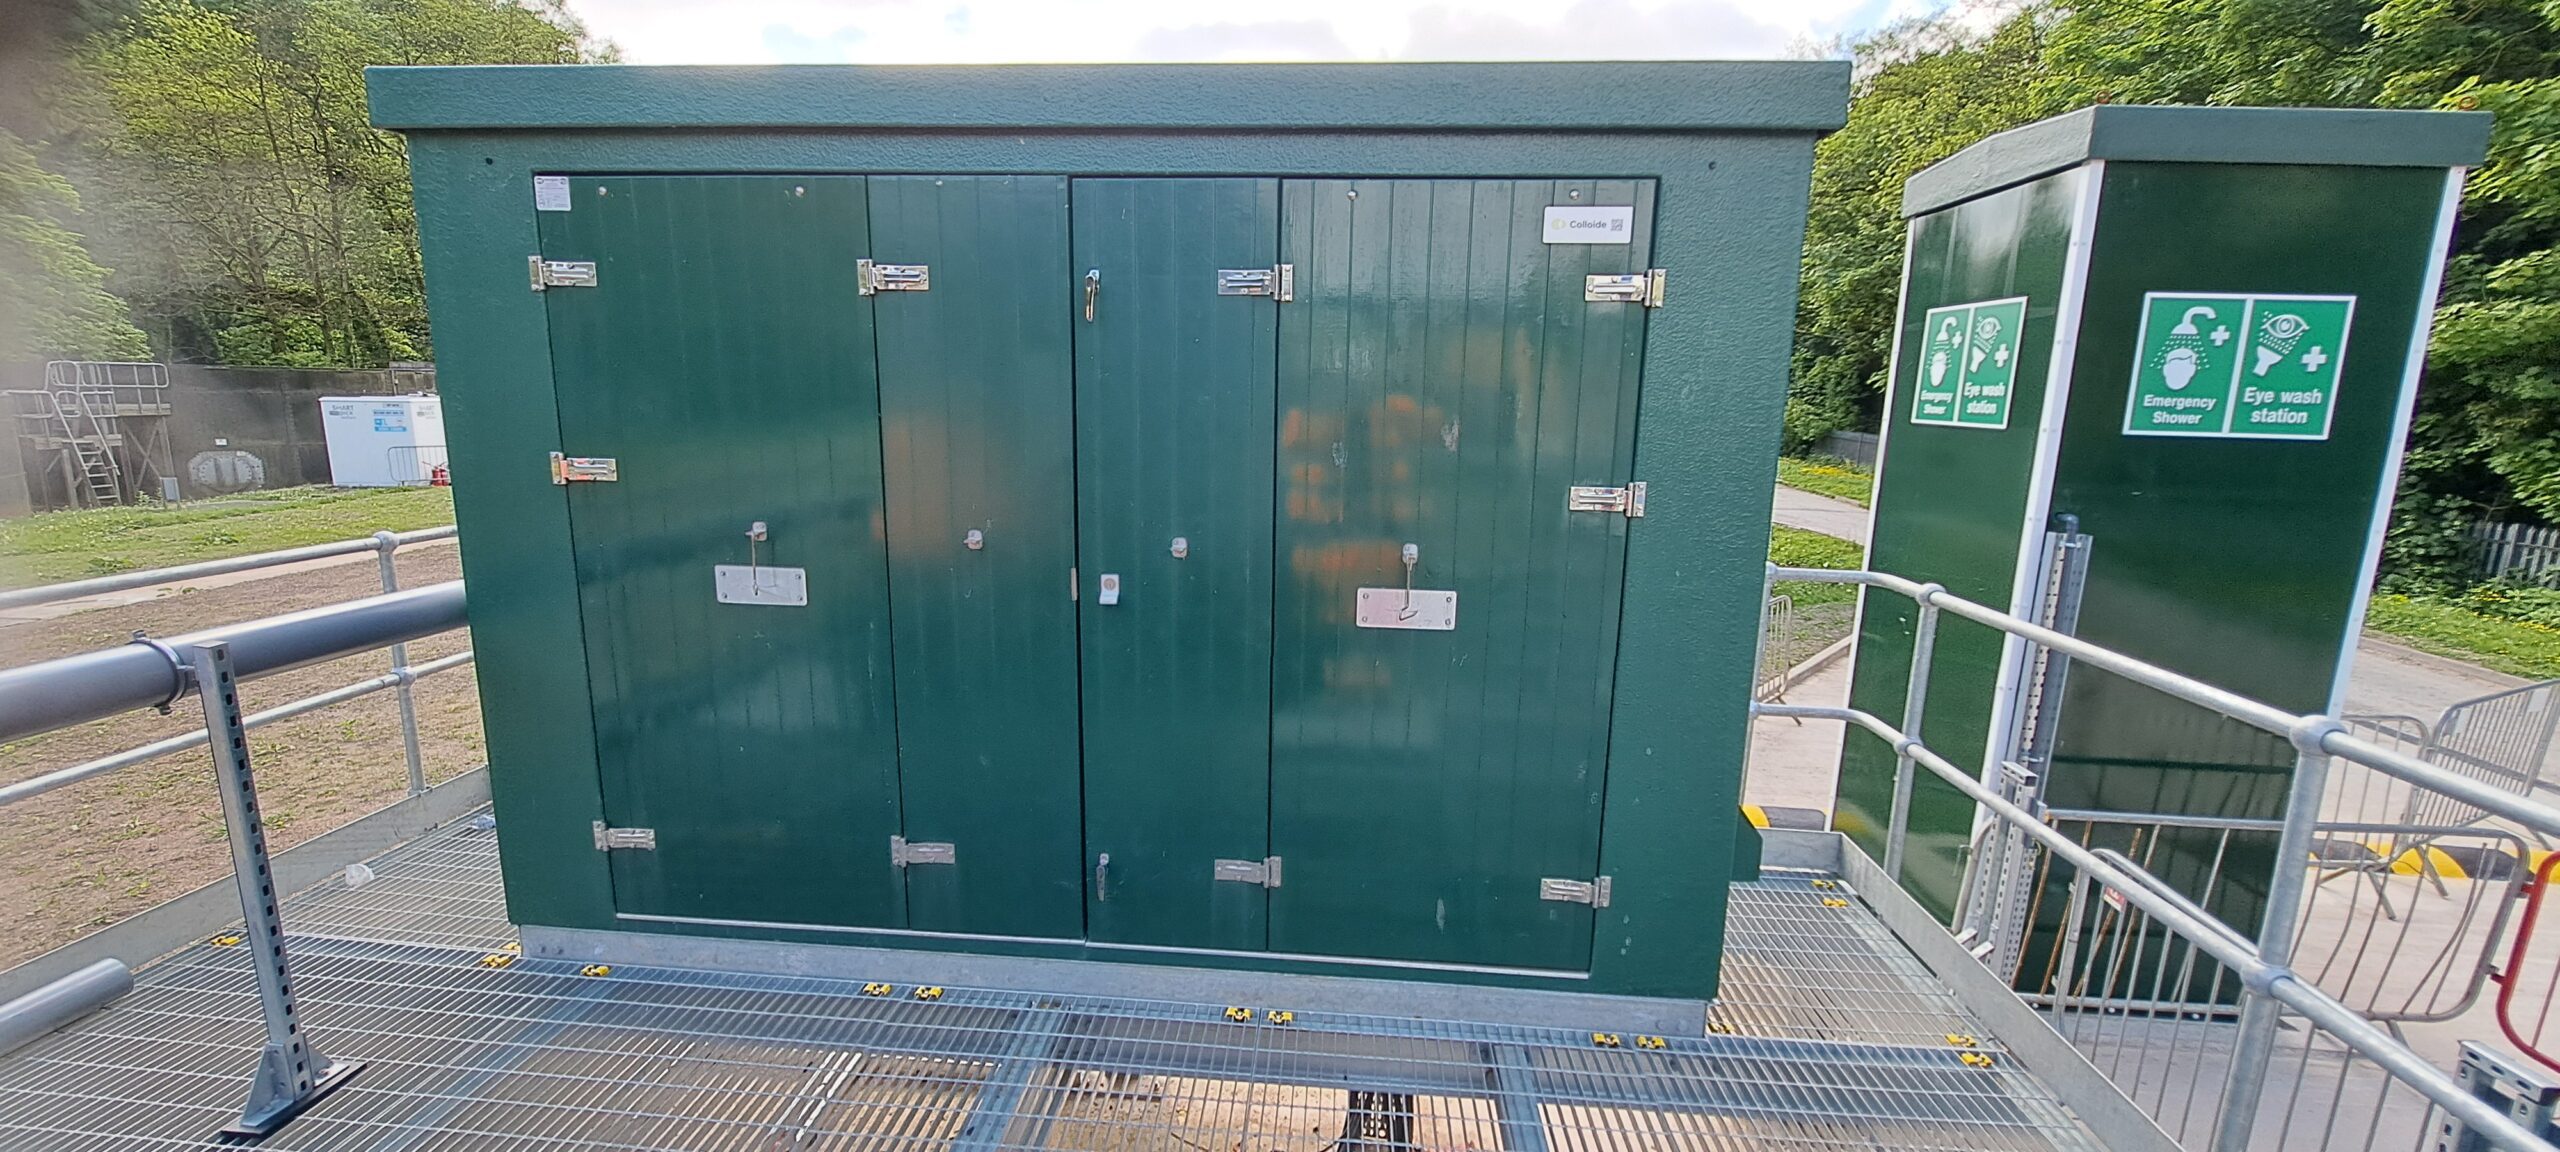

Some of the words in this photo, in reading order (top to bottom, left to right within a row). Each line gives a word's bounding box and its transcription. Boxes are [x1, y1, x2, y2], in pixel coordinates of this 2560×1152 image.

[1569, 220, 1607, 229] Colloide
[1963, 382, 1981, 399] Eye
[1982, 382, 2006, 397] wash
[2243, 386, 2275, 406] Eye
[2280, 388, 2323, 405] wash
[1966, 400, 1997, 414] station
[2143, 394, 2217, 411] Emergency
[2152, 411, 2203, 425] Shower
[2250, 407, 2308, 424] station
